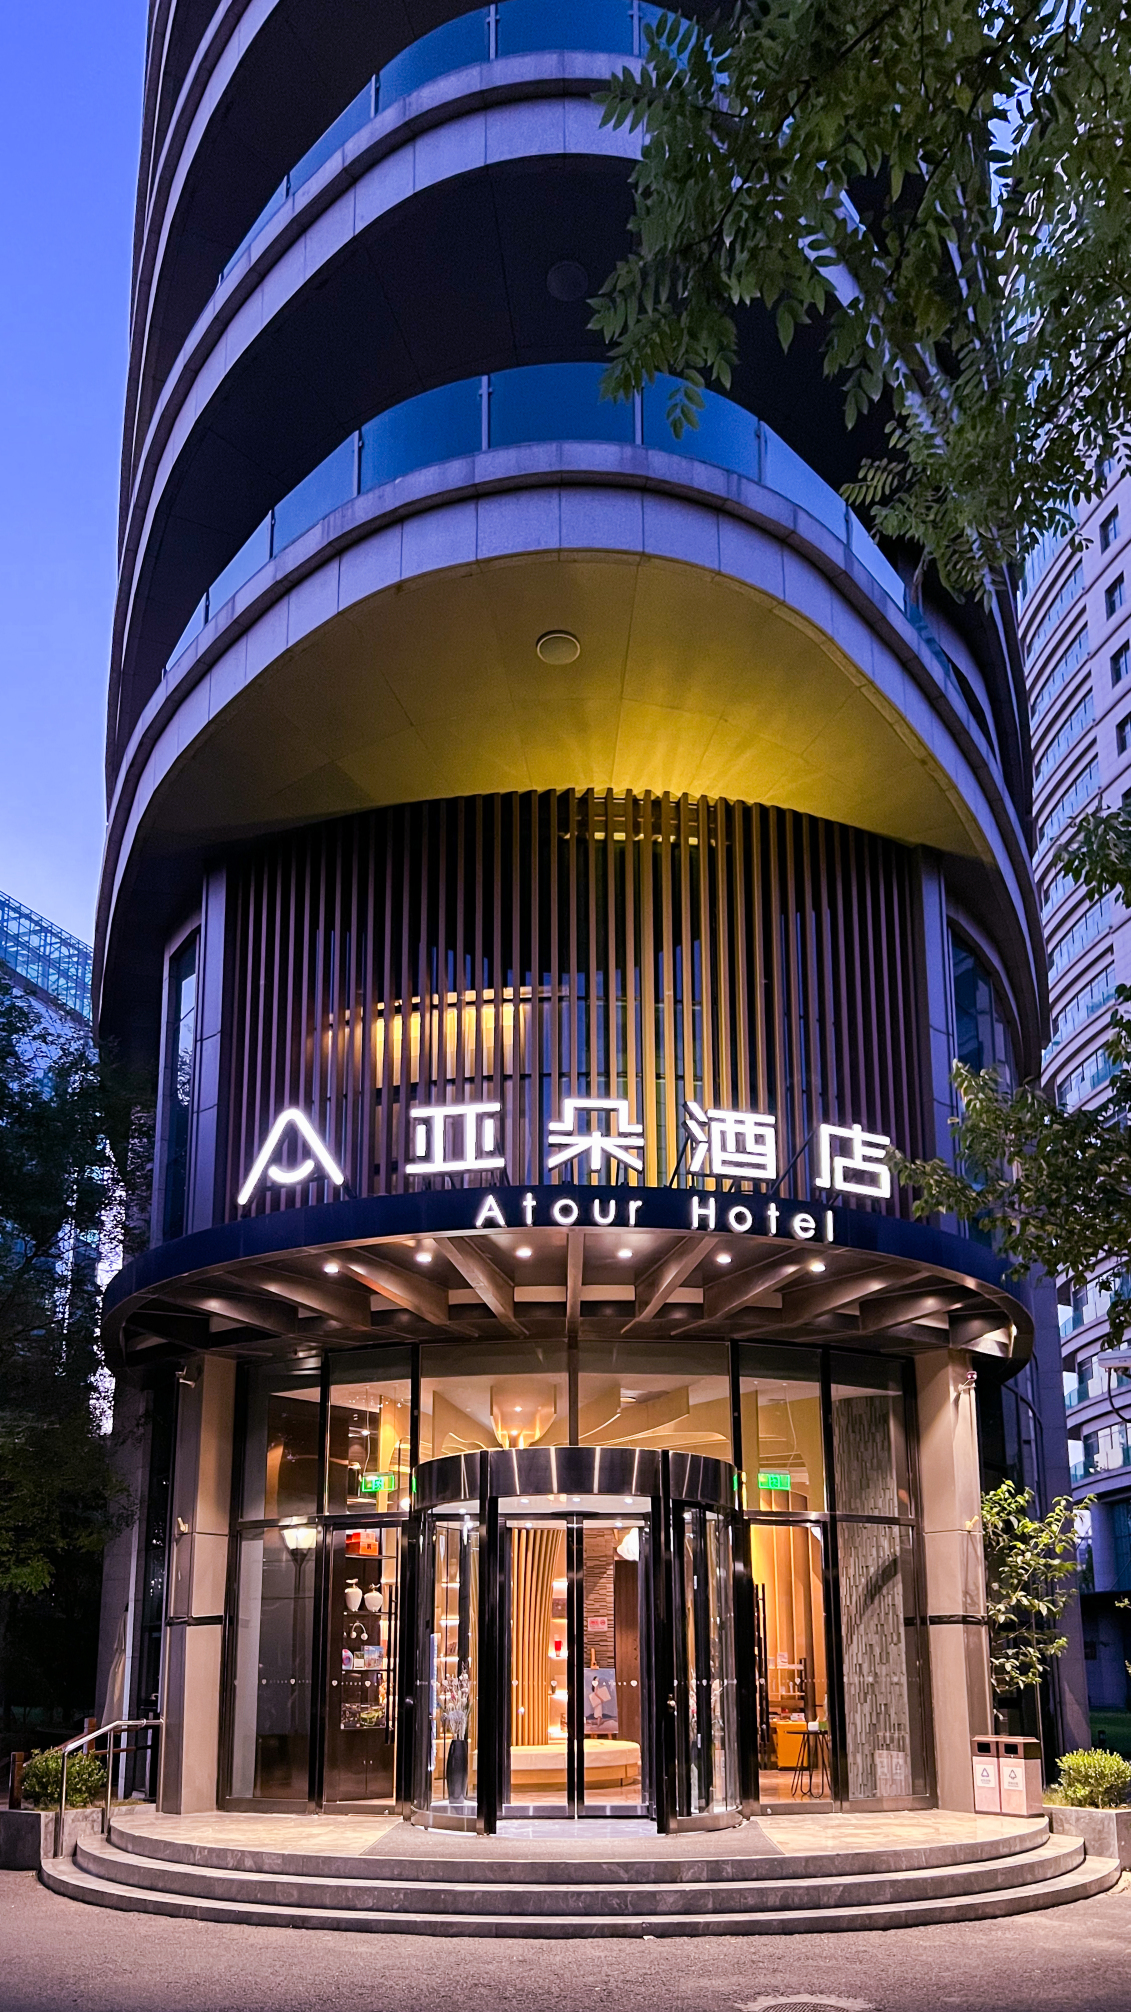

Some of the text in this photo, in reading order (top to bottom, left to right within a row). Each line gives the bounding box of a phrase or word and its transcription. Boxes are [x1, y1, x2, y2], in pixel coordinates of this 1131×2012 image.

[405, 1097, 892, 1200] 亚朵酒店
[475, 1192, 835, 1242] Atour Hotel
